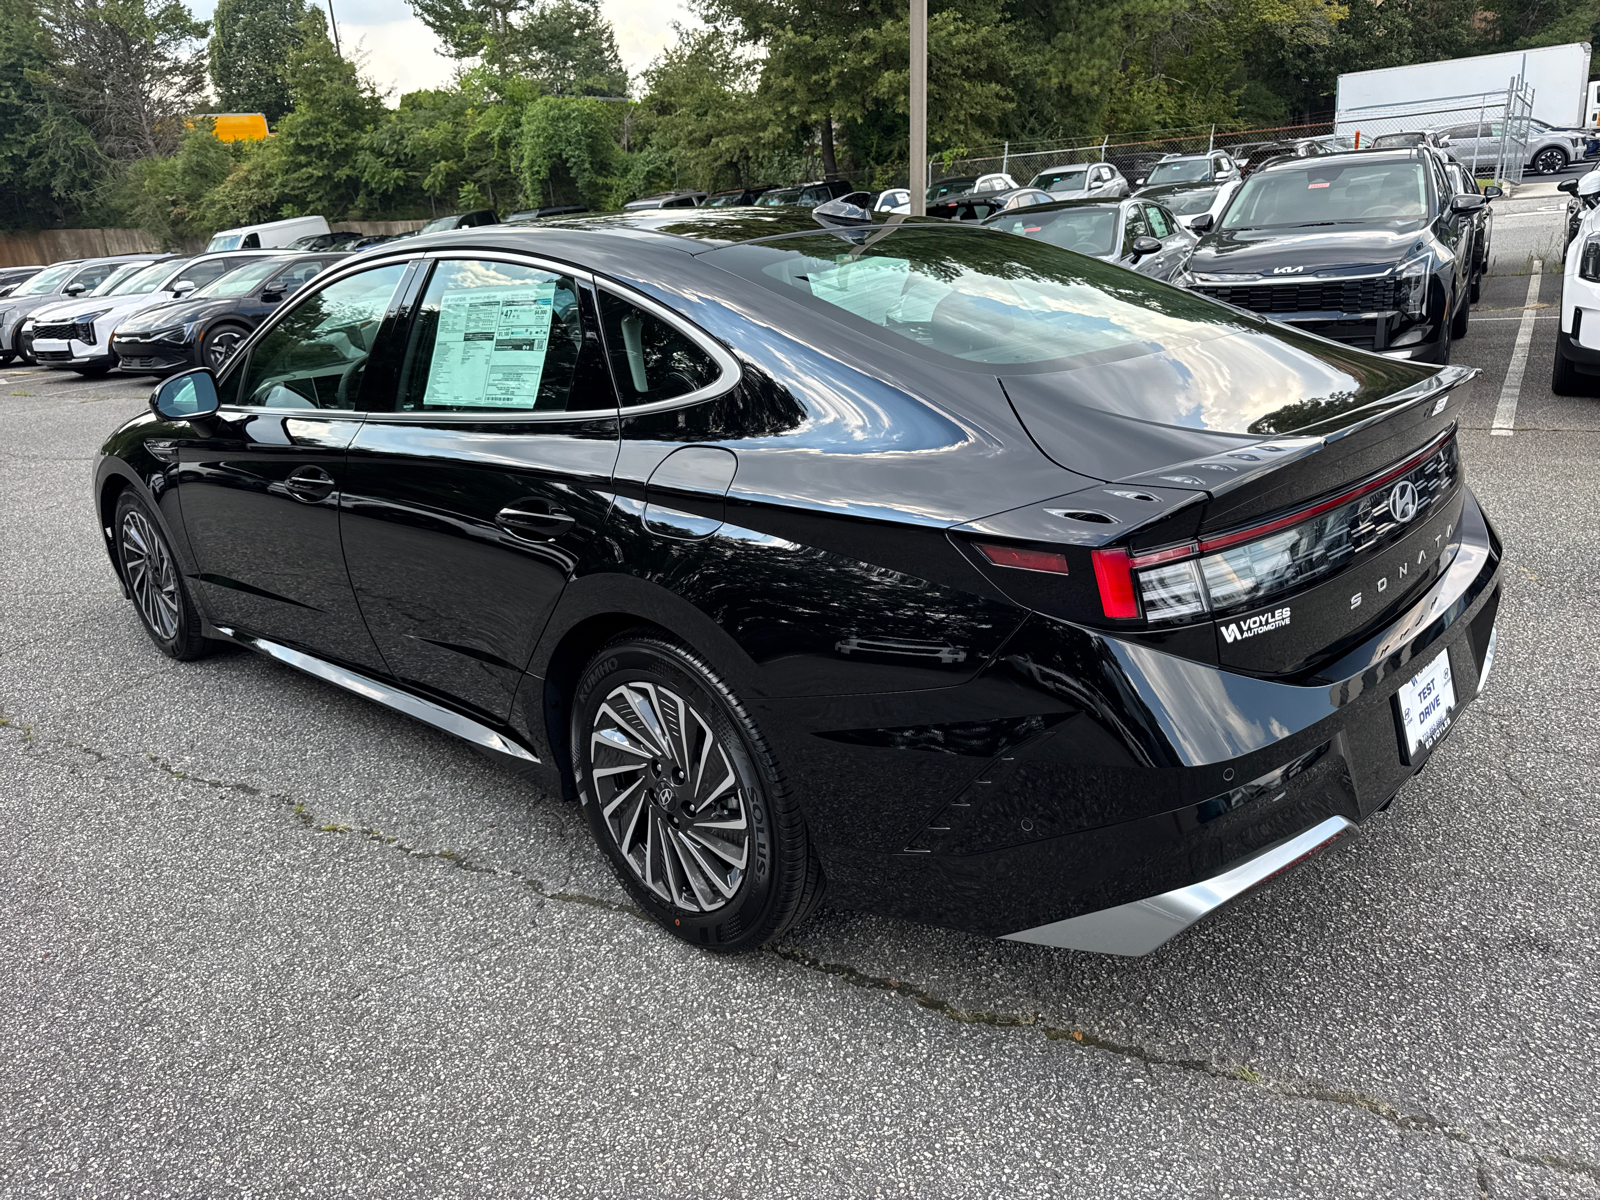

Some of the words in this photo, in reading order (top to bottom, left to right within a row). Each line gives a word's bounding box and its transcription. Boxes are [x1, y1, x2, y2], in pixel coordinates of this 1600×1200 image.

[504, 309, 513, 318] 47
[1350, 524, 1453, 610] SONATA
[1240, 607, 1291, 631] VOYLES
[1242, 617, 1291, 639] AUTOMOTIVE
[579, 657, 618, 704] KUMHO
[1417, 678, 1436, 704] TEST
[1418, 694, 1441, 726] DRIVE
[1433, 717, 1451, 741] VOYLES
[747, 786, 767, 876] SOLUS
